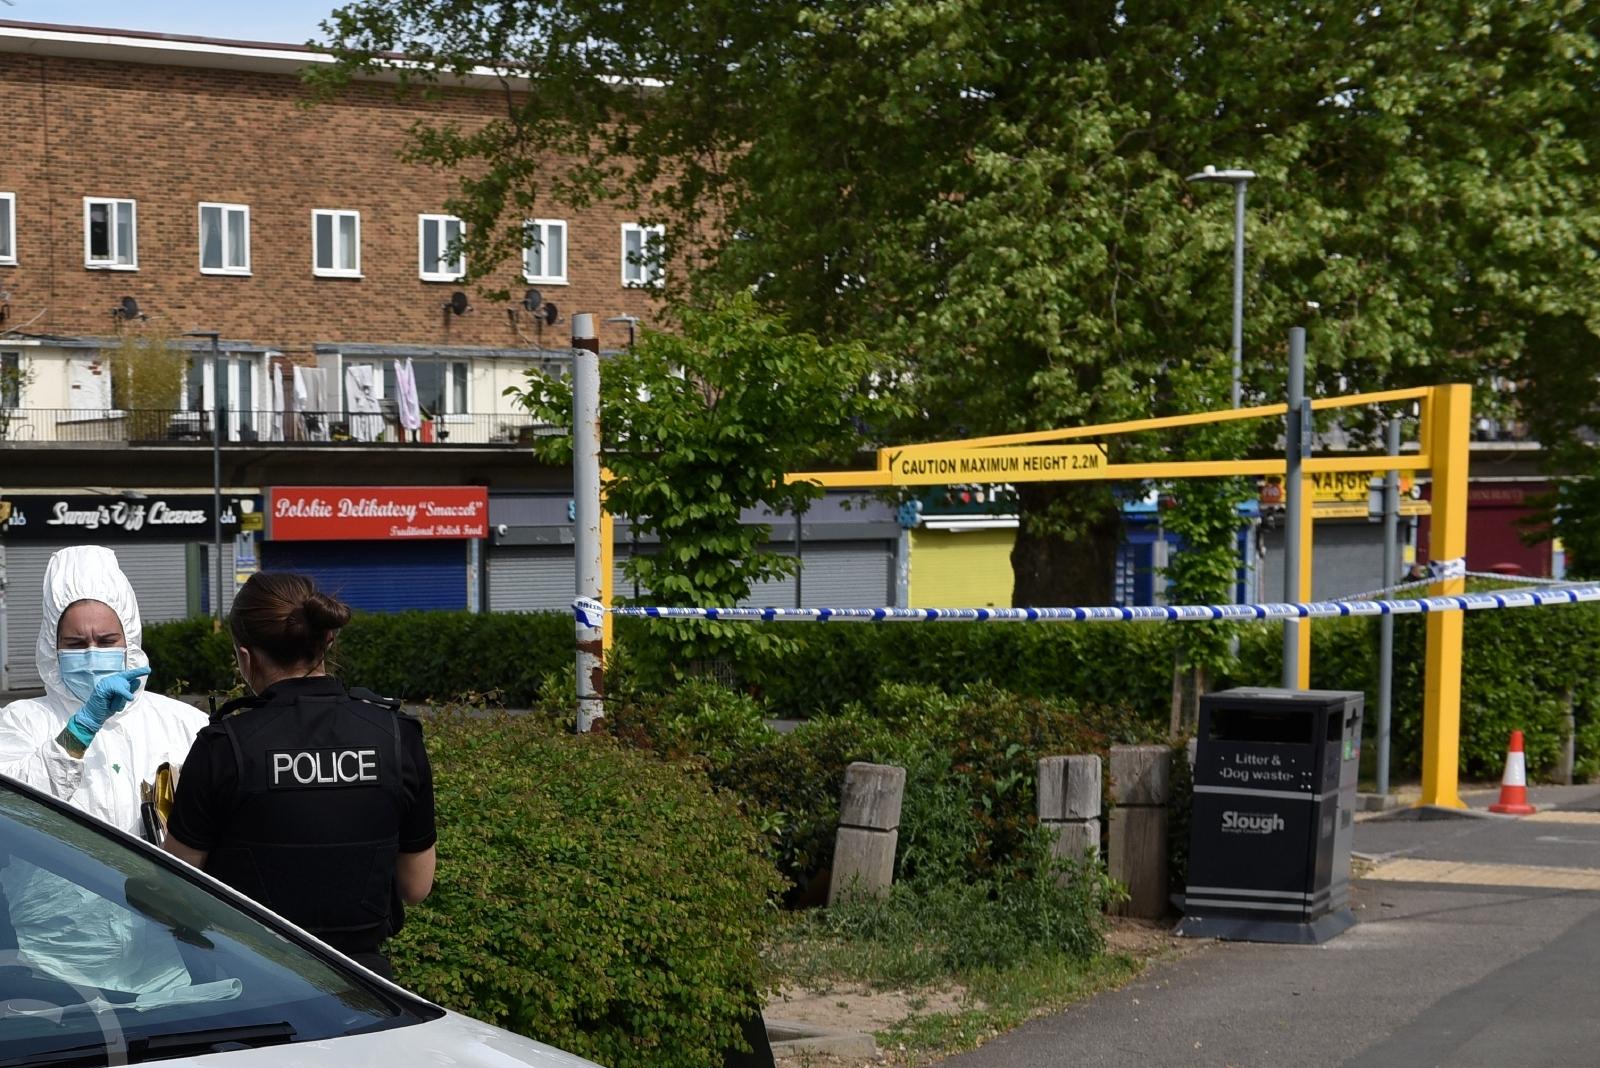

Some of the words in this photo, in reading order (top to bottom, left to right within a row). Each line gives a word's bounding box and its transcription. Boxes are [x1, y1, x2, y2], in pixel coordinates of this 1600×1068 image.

[902, 459, 956, 475] CAUTION
[960, 457, 1019, 473] MAXIMUM
[1023, 455, 1068, 471] HEIGHT
[1072, 454, 1098, 470] 2.2M
[47, 501, 110, 529] Sunny's
[111, 501, 146, 531] Off
[148, 501, 207, 525] Licence
[275, 498, 333, 518] Polskie
[337, 498, 416, 523] Delikatesy
[273, 750, 377, 784] POLICE
[1235, 753, 1269, 765] Litter
[1271, 755, 1281, 765] &
[1223, 767, 1249, 781] Dog
[1252, 771, 1290, 781] waste
[1222, 811, 1284, 834] Slough
